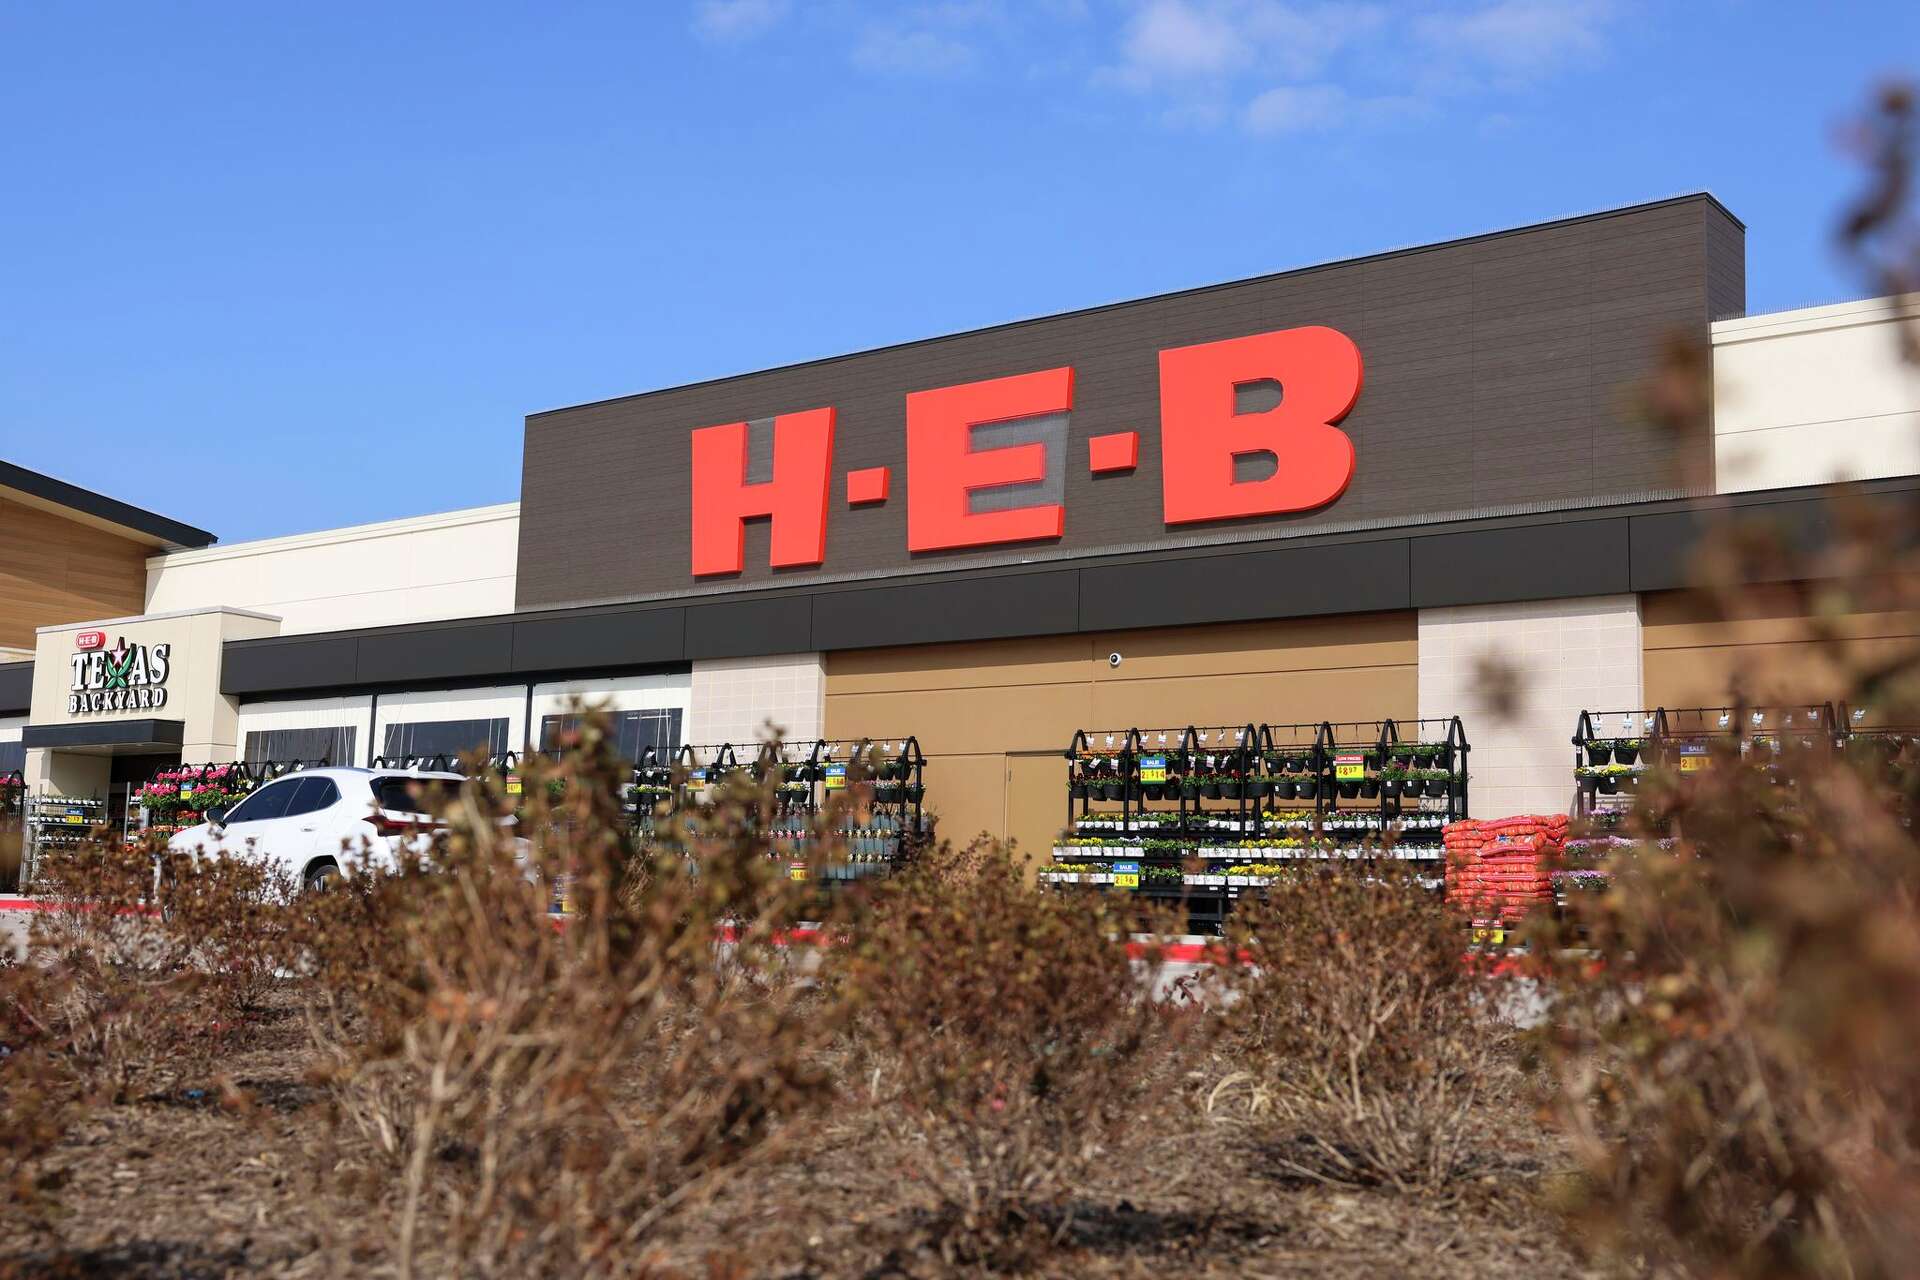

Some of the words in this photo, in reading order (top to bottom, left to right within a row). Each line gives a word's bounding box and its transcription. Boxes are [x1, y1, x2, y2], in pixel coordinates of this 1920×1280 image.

[691, 325, 1363, 576] H-E-B
[71, 639, 170, 691] TEXAS
[68, 687, 167, 713] BACKYARD
